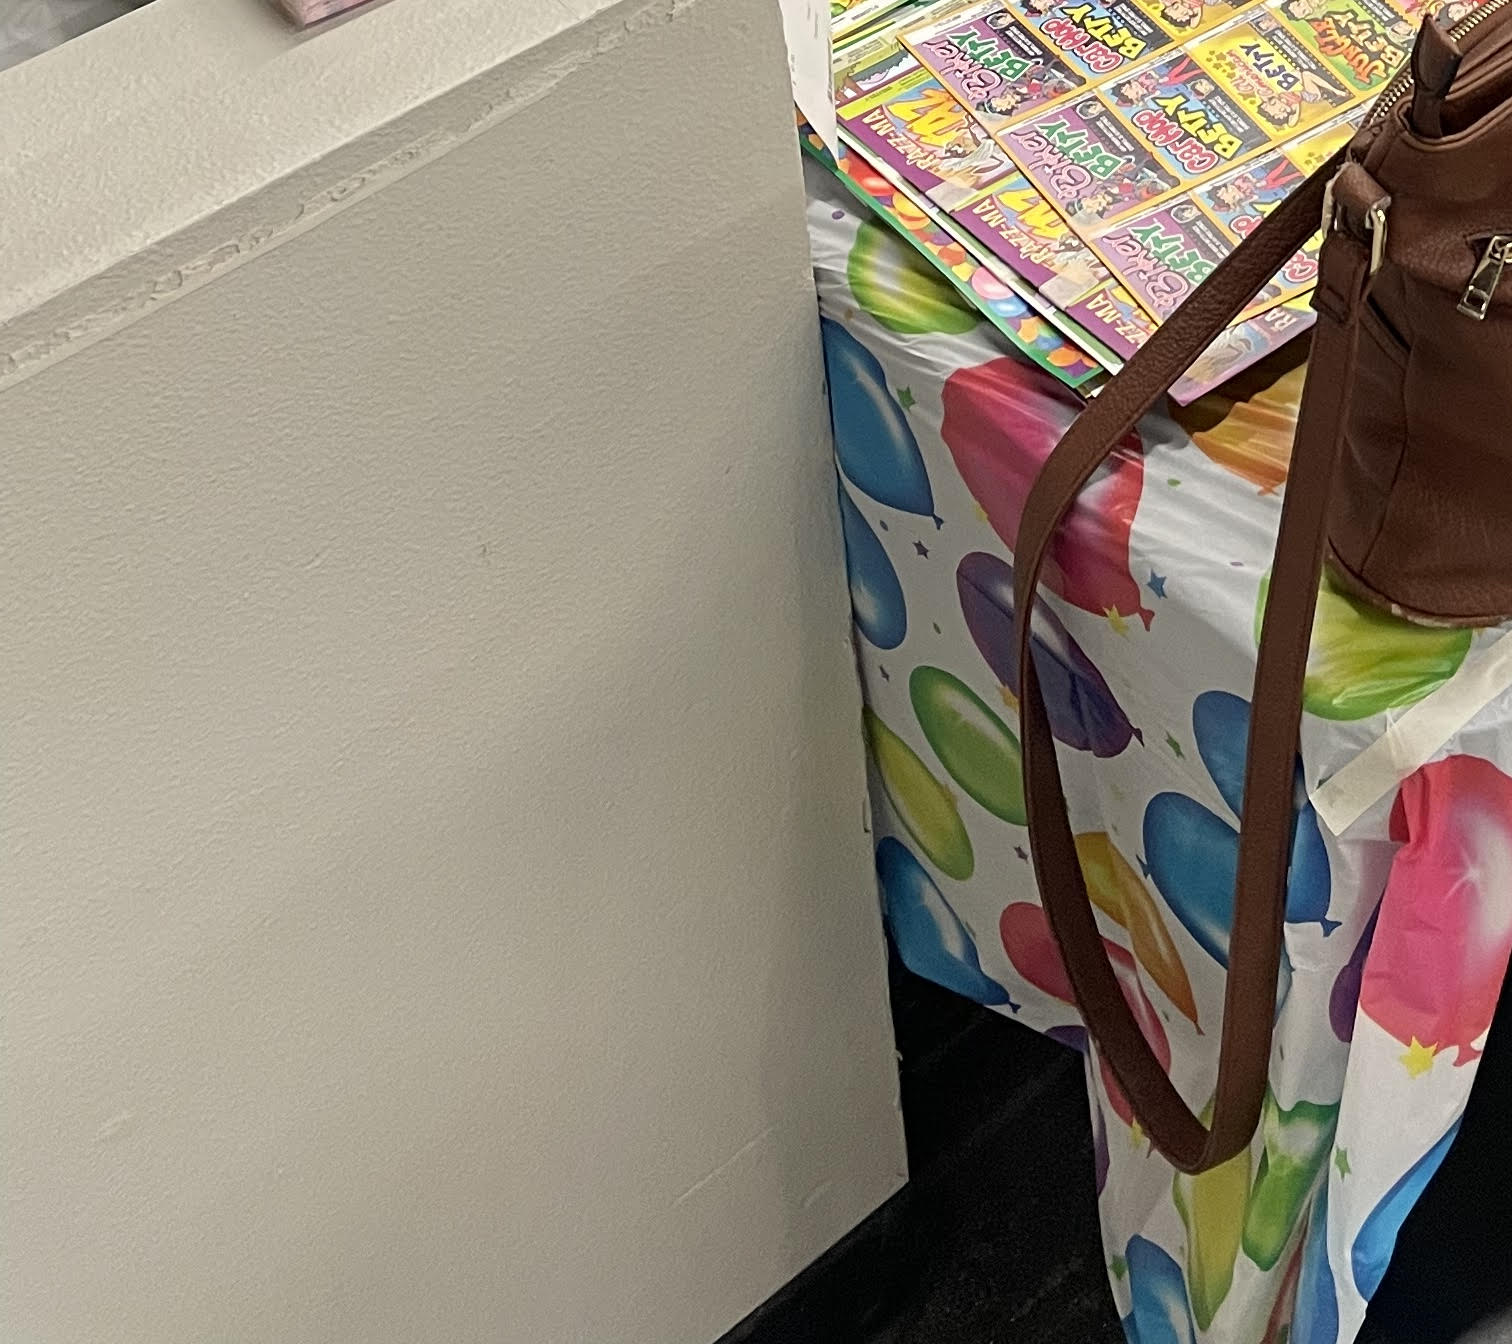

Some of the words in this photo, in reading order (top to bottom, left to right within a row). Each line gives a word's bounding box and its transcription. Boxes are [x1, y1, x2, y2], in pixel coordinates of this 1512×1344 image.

[949, 27, 1032, 82] BETTY
[1062, 2, 1149, 60] BETTY
[1307, 16, 1388, 84] JUNGLE
[1321, 10, 1405, 70] BETTY
[923, 38, 1003, 102] Biker
[1240, 43, 1302, 92] BETTY
[860, 107, 938, 173] RAZZ-MA
[1037, 115, 1122, 180] BETTY
[1151, 94, 1244, 161] BETTY
[1009, 130, 1092, 199] Biker
[971, 192, 1049, 266] RAZZ-MA
[1102, 233, 1190, 308] Biker
